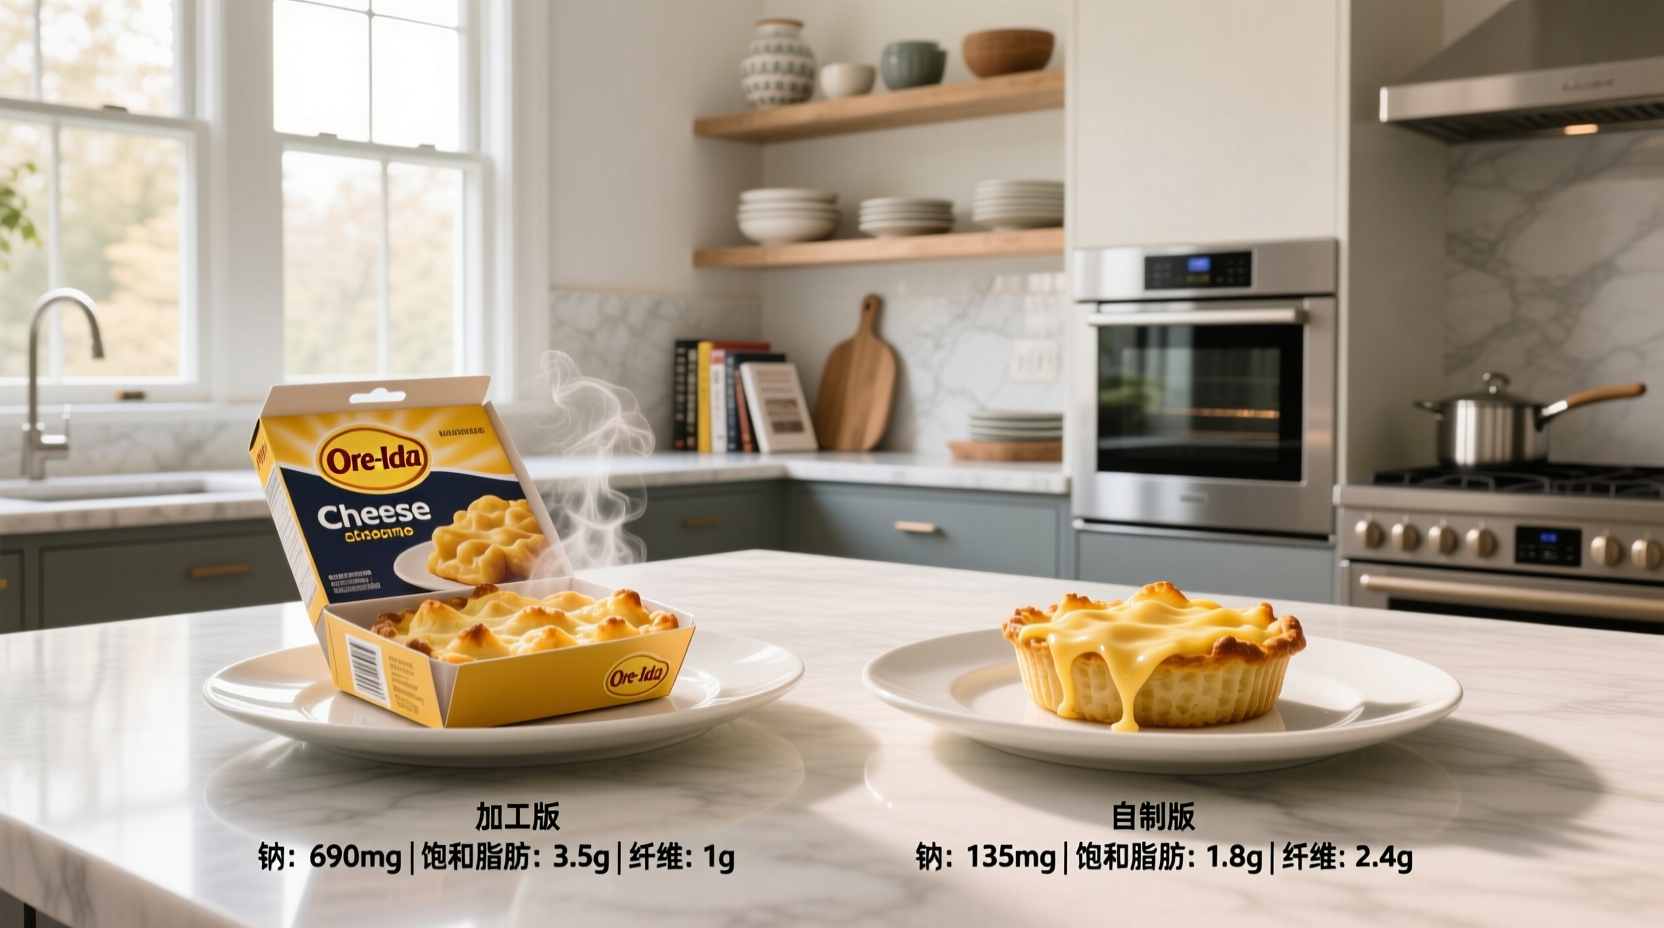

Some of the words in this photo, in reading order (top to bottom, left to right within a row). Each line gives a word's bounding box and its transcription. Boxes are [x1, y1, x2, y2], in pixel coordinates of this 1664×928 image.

[326, 444, 422, 475] Ore-Ida
[317, 501, 432, 530] Cheese
[609, 664, 663, 688] Ore-Ida
